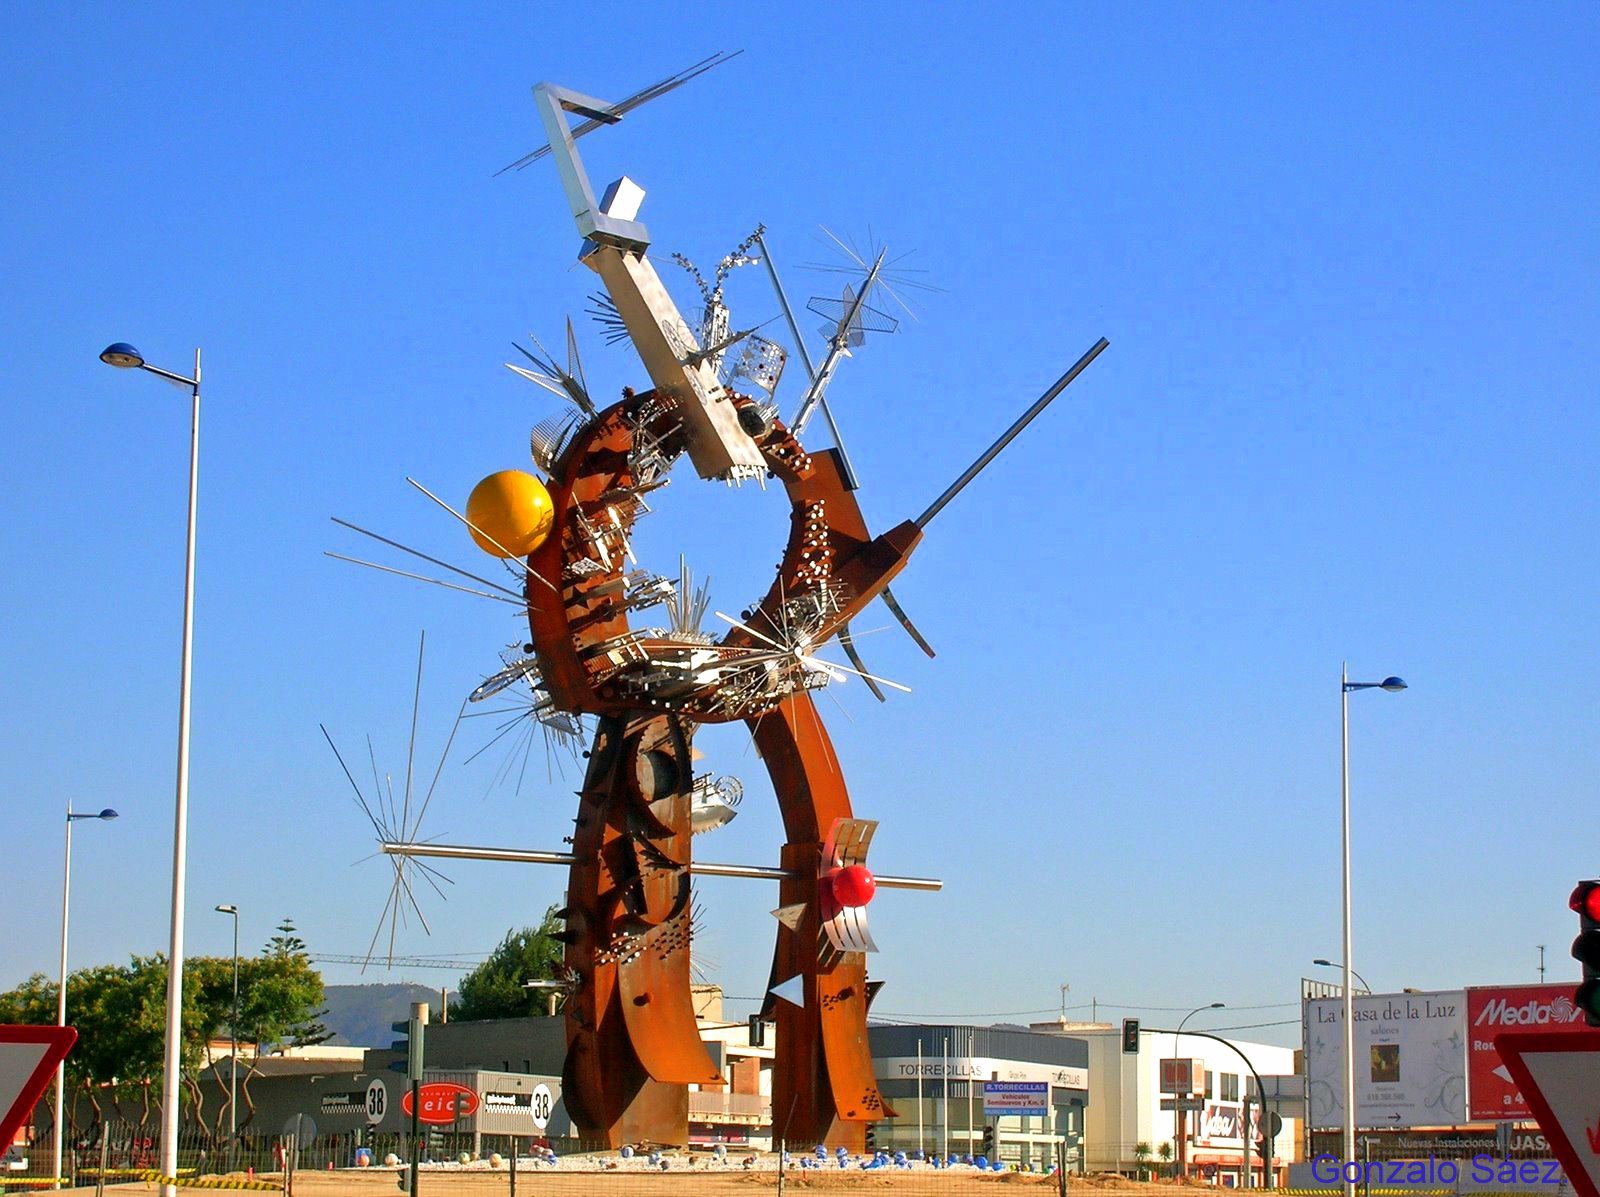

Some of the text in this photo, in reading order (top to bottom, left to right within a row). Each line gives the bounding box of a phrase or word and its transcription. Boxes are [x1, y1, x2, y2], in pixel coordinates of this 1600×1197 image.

[1318, 1007, 1336, 1023] La
[1383, 1002, 1400, 1020] de
[1406, 1001, 1419, 1019] la
[1426, 1001, 1456, 1018] Luz
[899, 1064, 983, 1076] TORRECILLAS
[369, 1087, 384, 1116] 38
[534, 1092, 549, 1120] 38
[1503, 1095, 1512, 1105] a
[1435, 1136, 1495, 1148] Instalaciones
